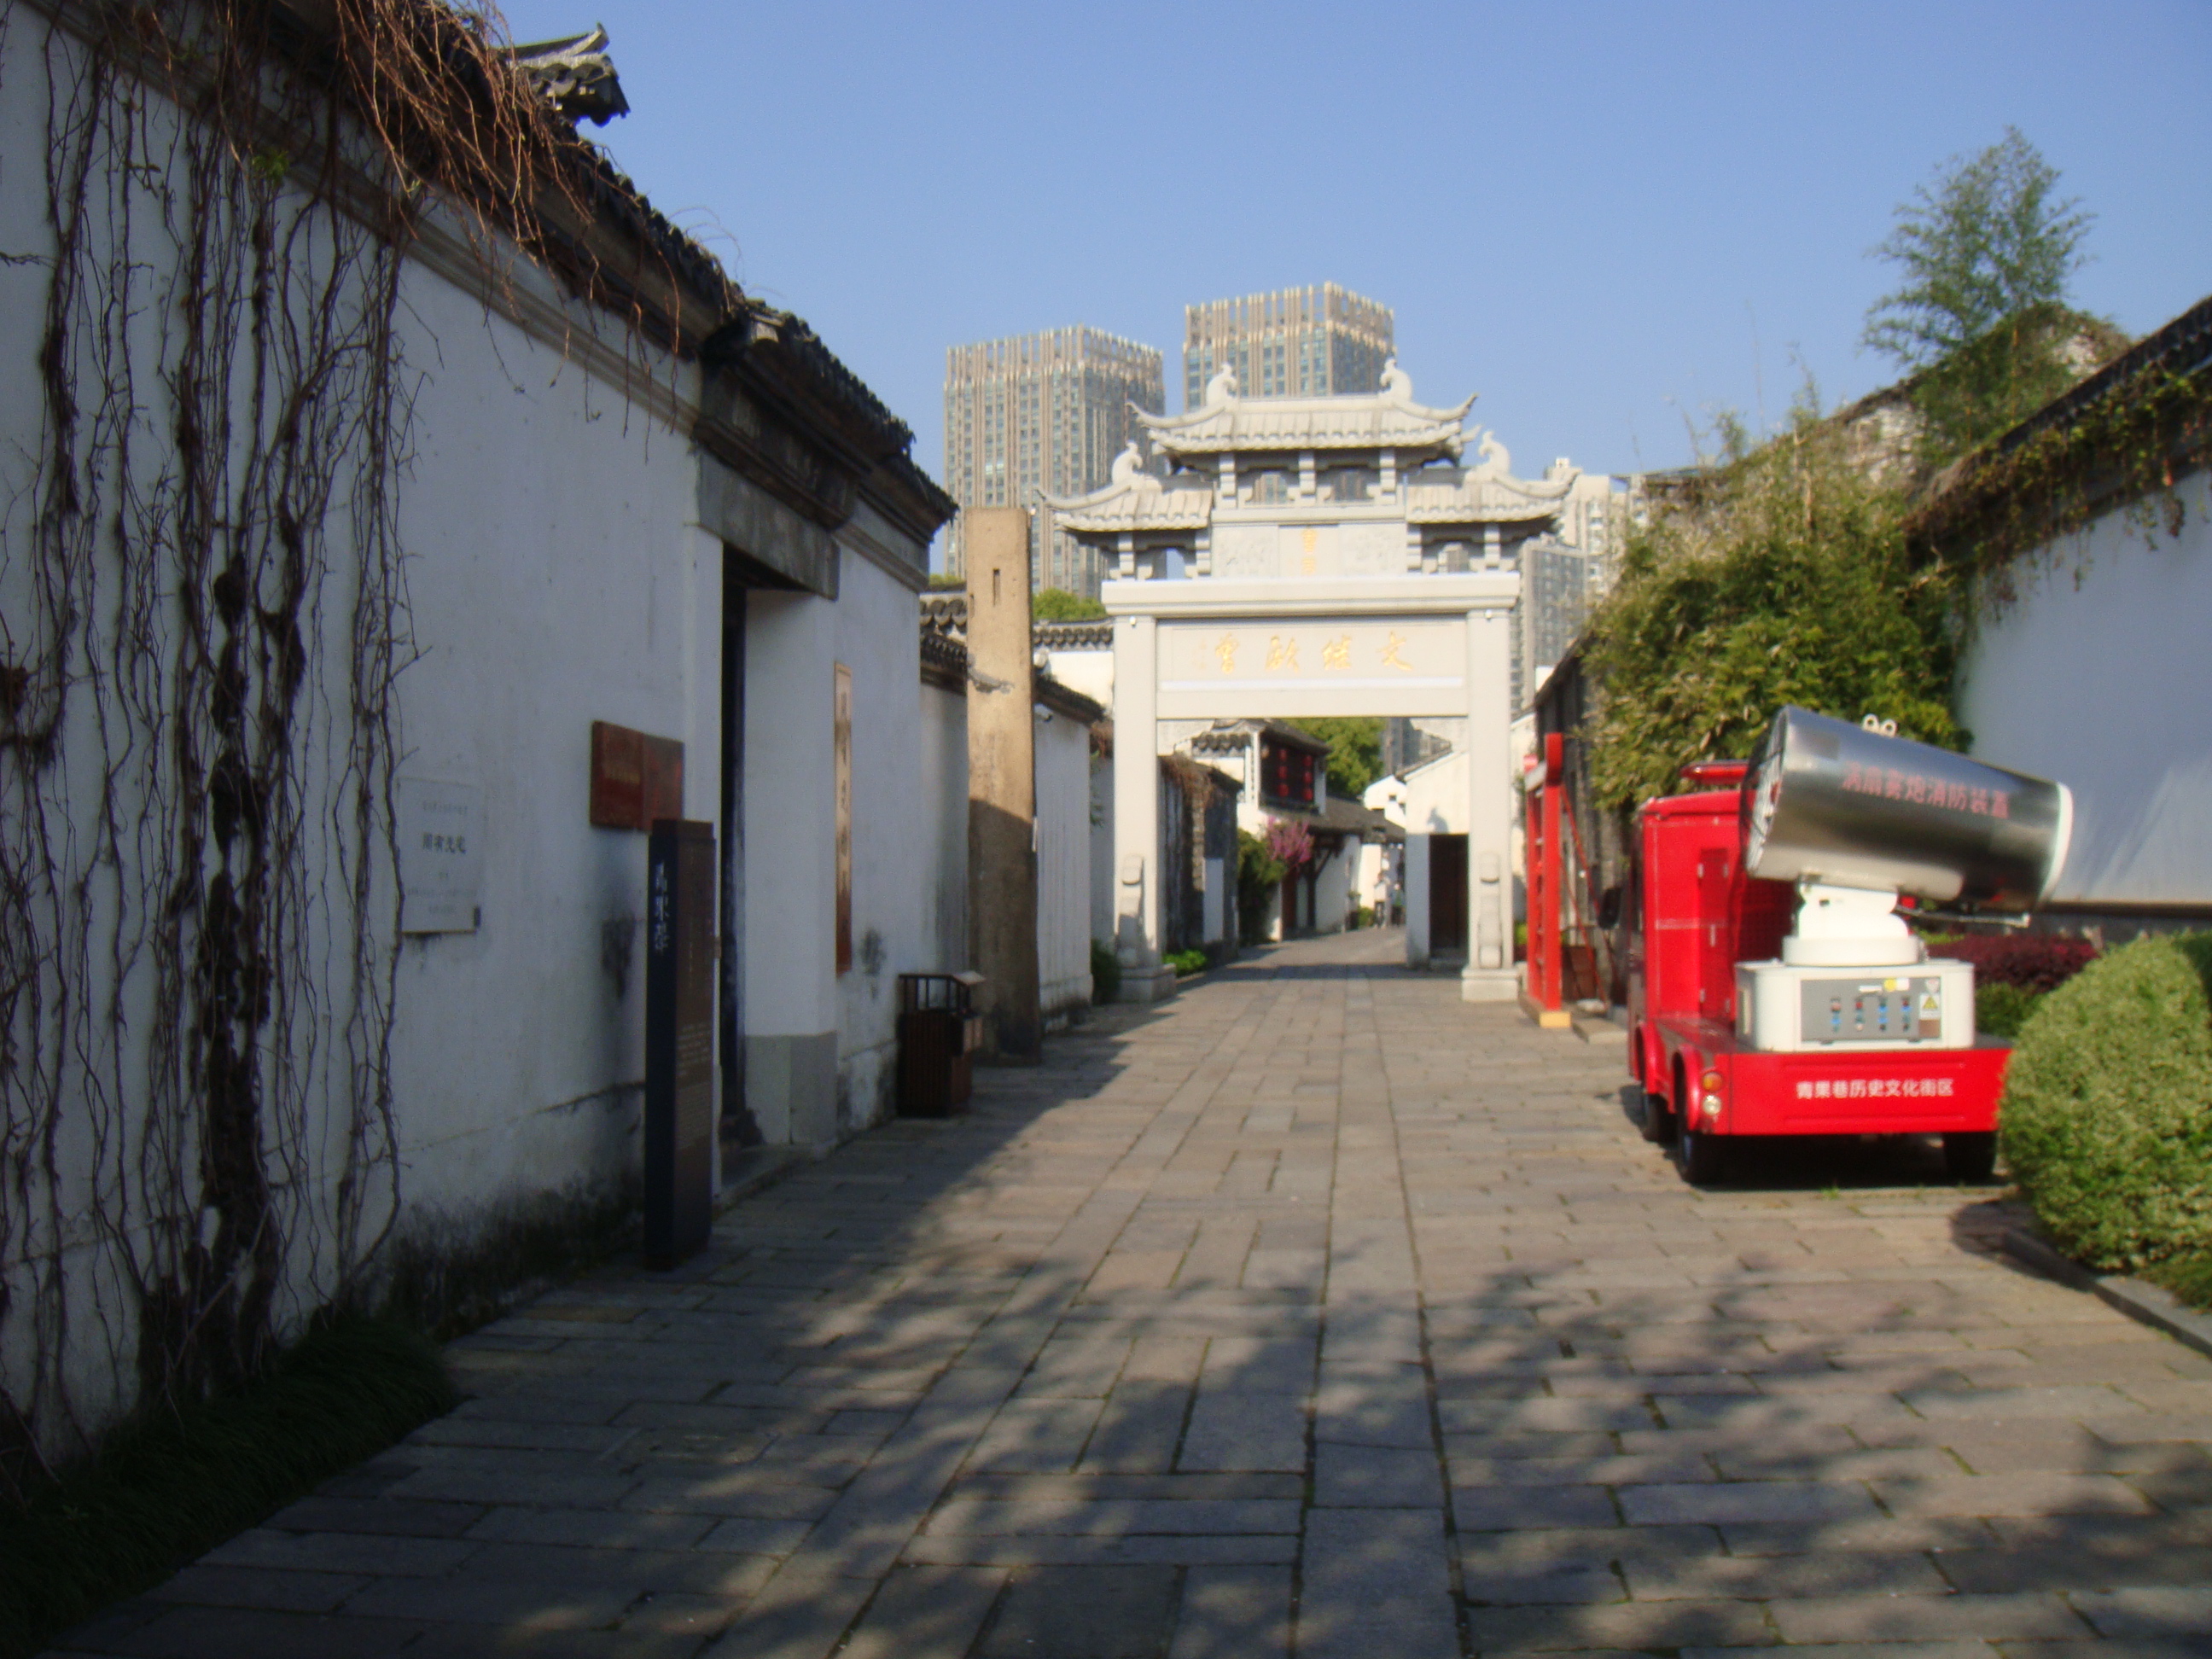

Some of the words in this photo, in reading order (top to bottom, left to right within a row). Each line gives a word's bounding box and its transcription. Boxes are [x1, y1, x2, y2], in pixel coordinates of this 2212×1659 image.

[1796, 1077, 1954, 1099] 青果巷历史文化街区
